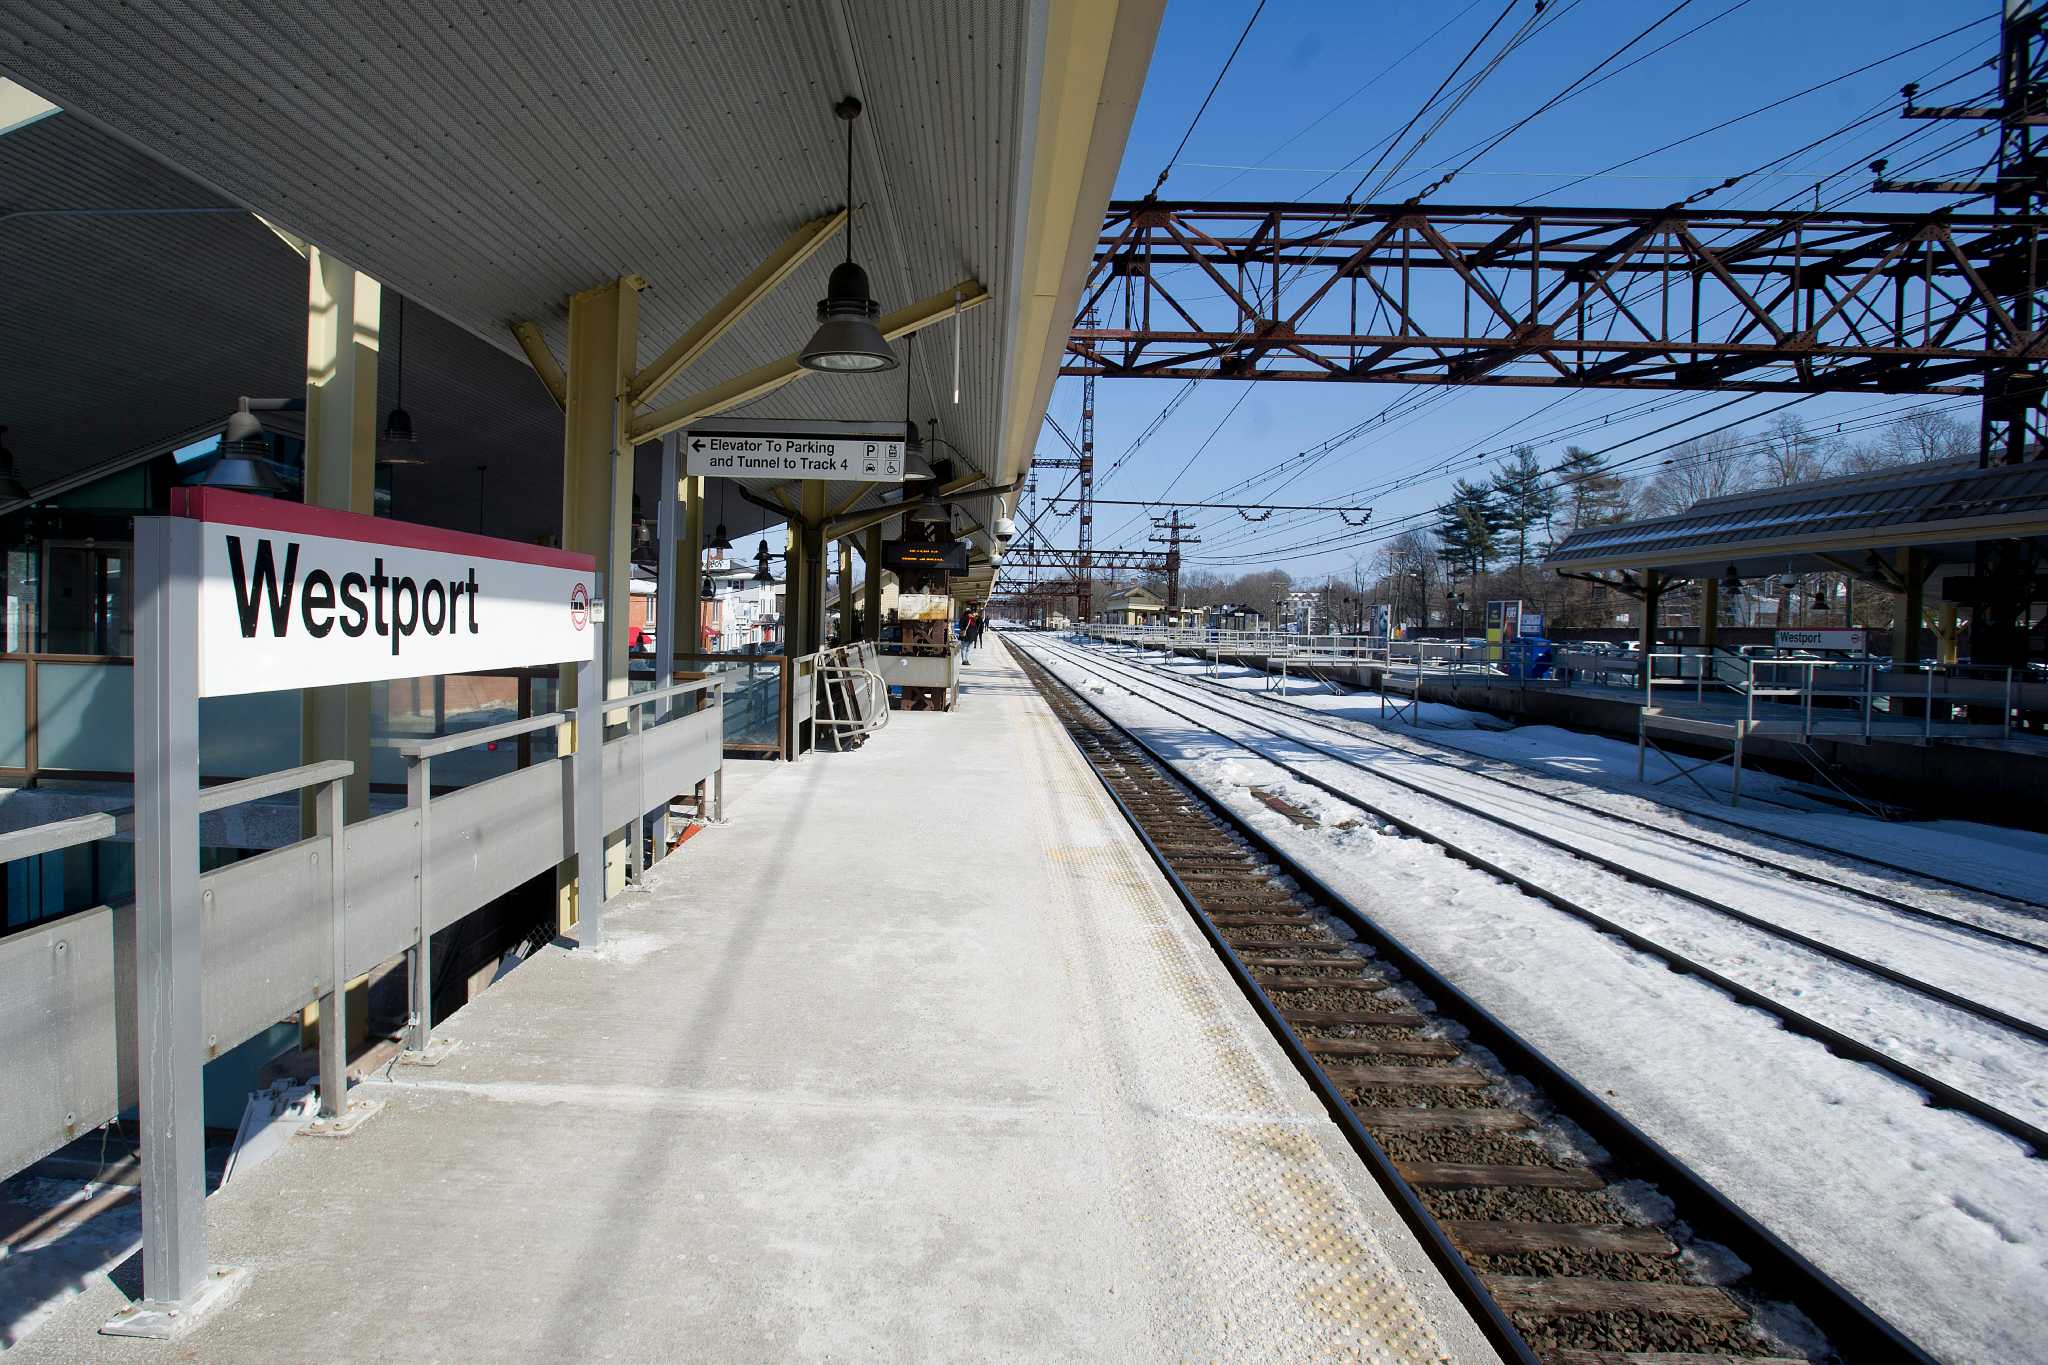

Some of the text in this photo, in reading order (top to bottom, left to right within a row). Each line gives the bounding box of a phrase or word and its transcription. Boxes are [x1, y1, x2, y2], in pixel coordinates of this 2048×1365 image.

[710, 439, 835, 456] Elevator To Parking
[866, 445, 876, 457] P
[710, 456, 849, 470] and Tunnel to Track 4
[226, 535, 479, 656] Westport
[1780, 632, 1822, 645] Westport
